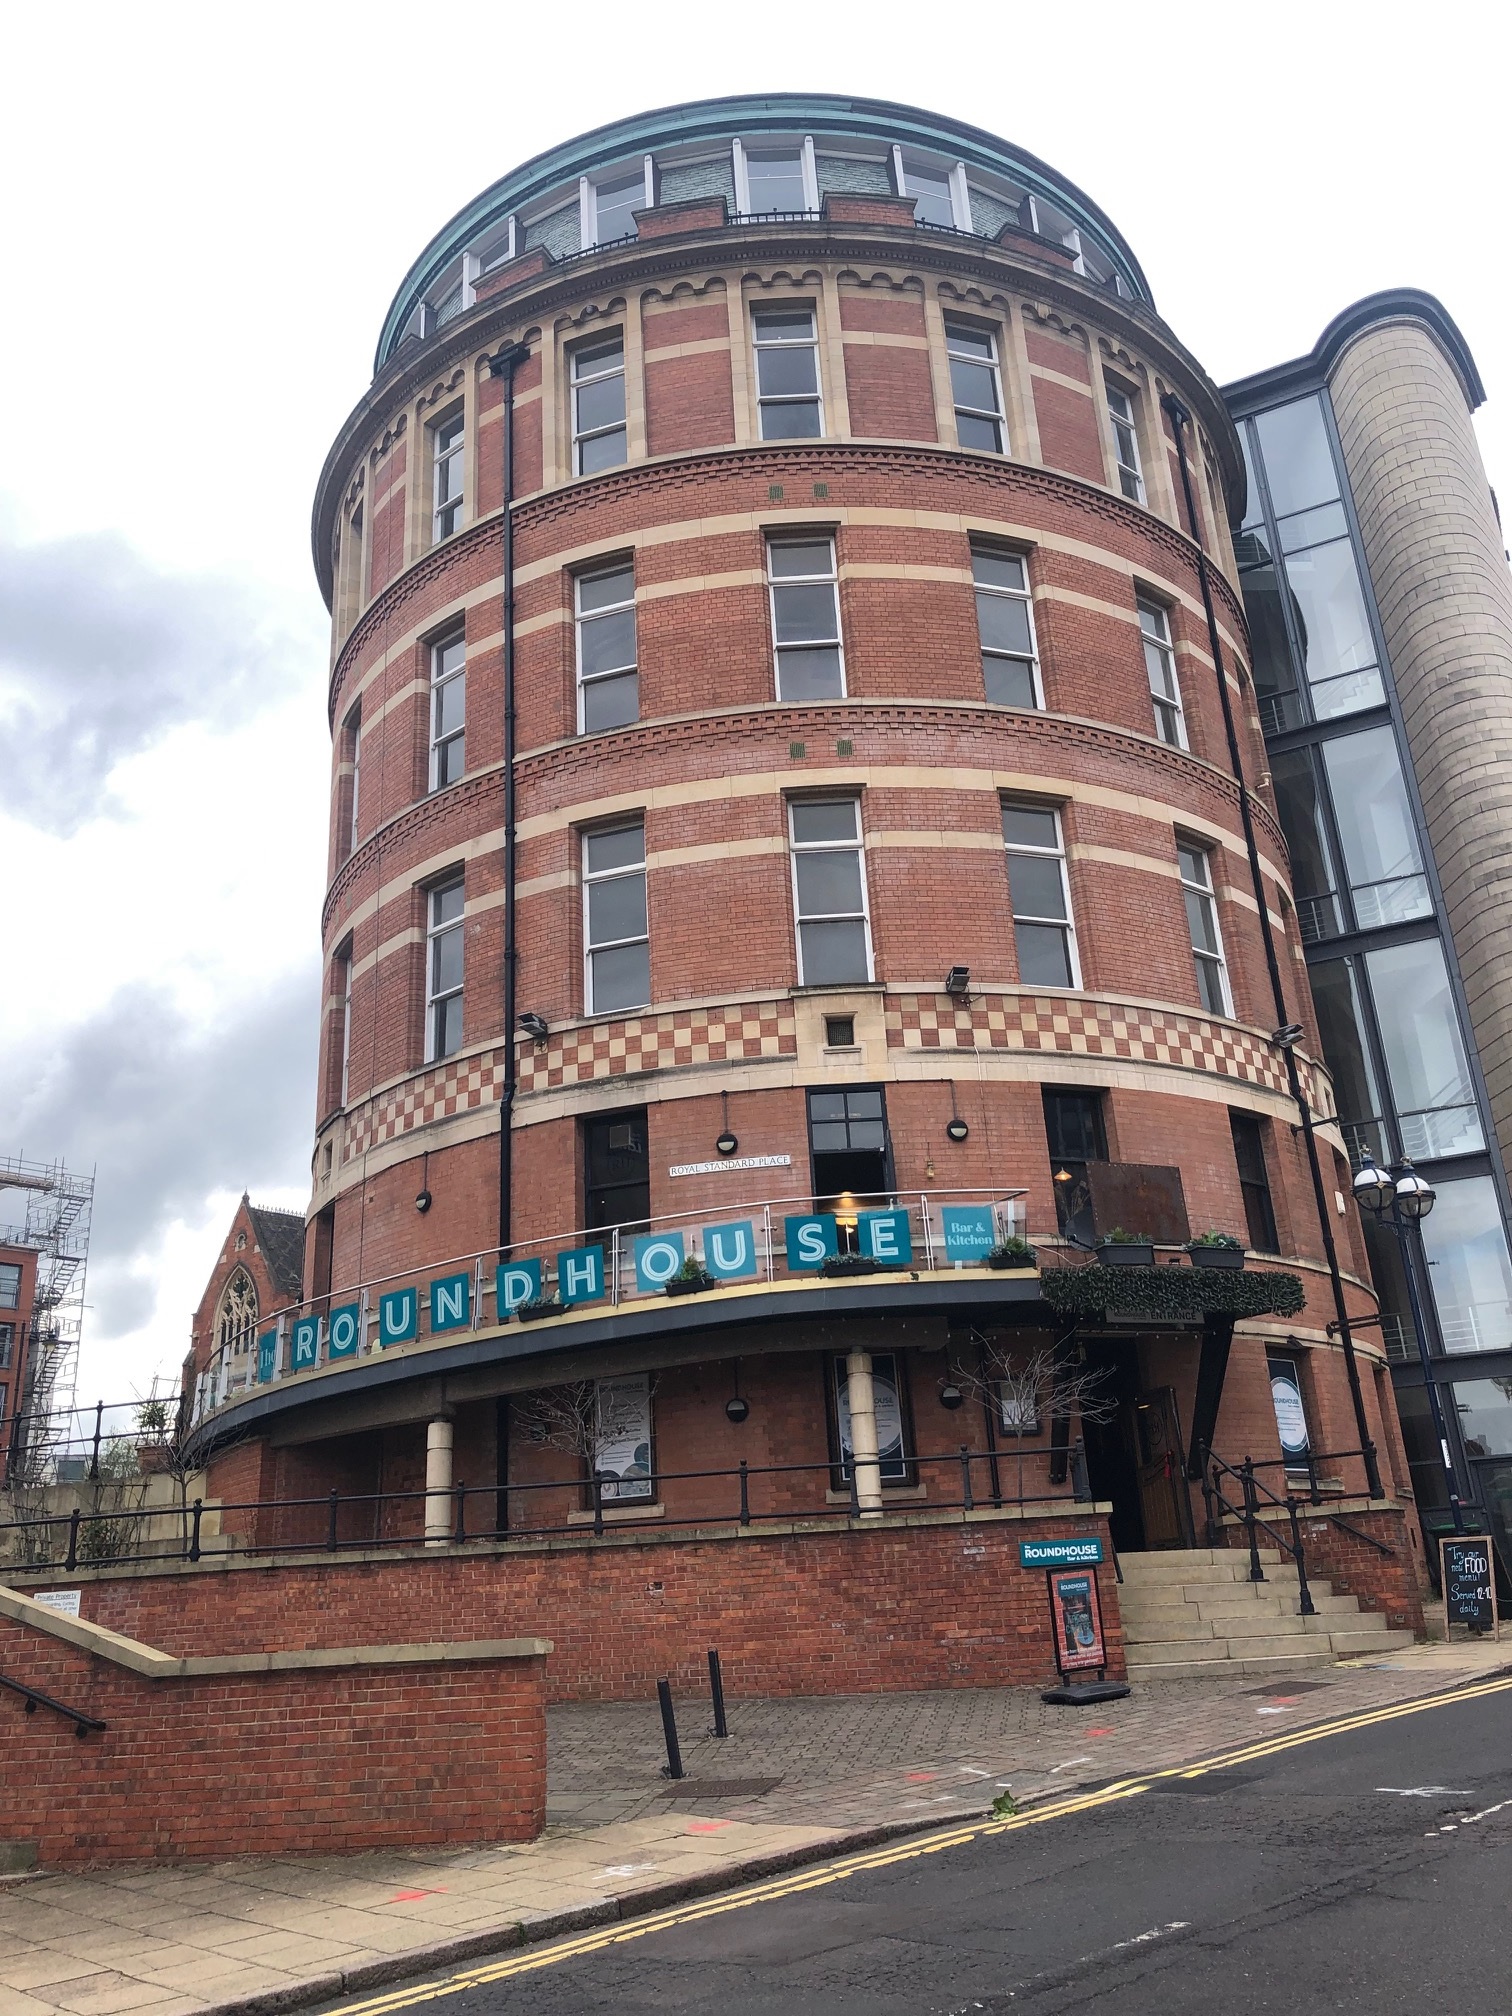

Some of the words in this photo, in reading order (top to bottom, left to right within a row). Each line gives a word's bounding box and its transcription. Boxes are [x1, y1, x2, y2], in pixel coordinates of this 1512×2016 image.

[671, 1165, 700, 1175] ROYAL
[704, 1158, 755, 1171] STANDARD
[760, 1156, 789, 1166] PLACE
[952, 1222, 973, 1233] Bar
[976, 1221, 985, 1232] &
[948, 1234, 992, 1246] Kitchen
[296, 1218, 899, 1361] ROUNDHOUSE
[1274, 1397, 1299, 1405] OUNDHOUSE
[1024, 1545, 1098, 1559] ROUNDHOUSE
[1447, 1545, 1464, 1564] Try
[1451, 1564, 1463, 1572] new
[1464, 1557, 1487, 1573] FOOD
[1451, 1583, 1476, 1601] Served
[1460, 1601, 1479, 1616] daily
